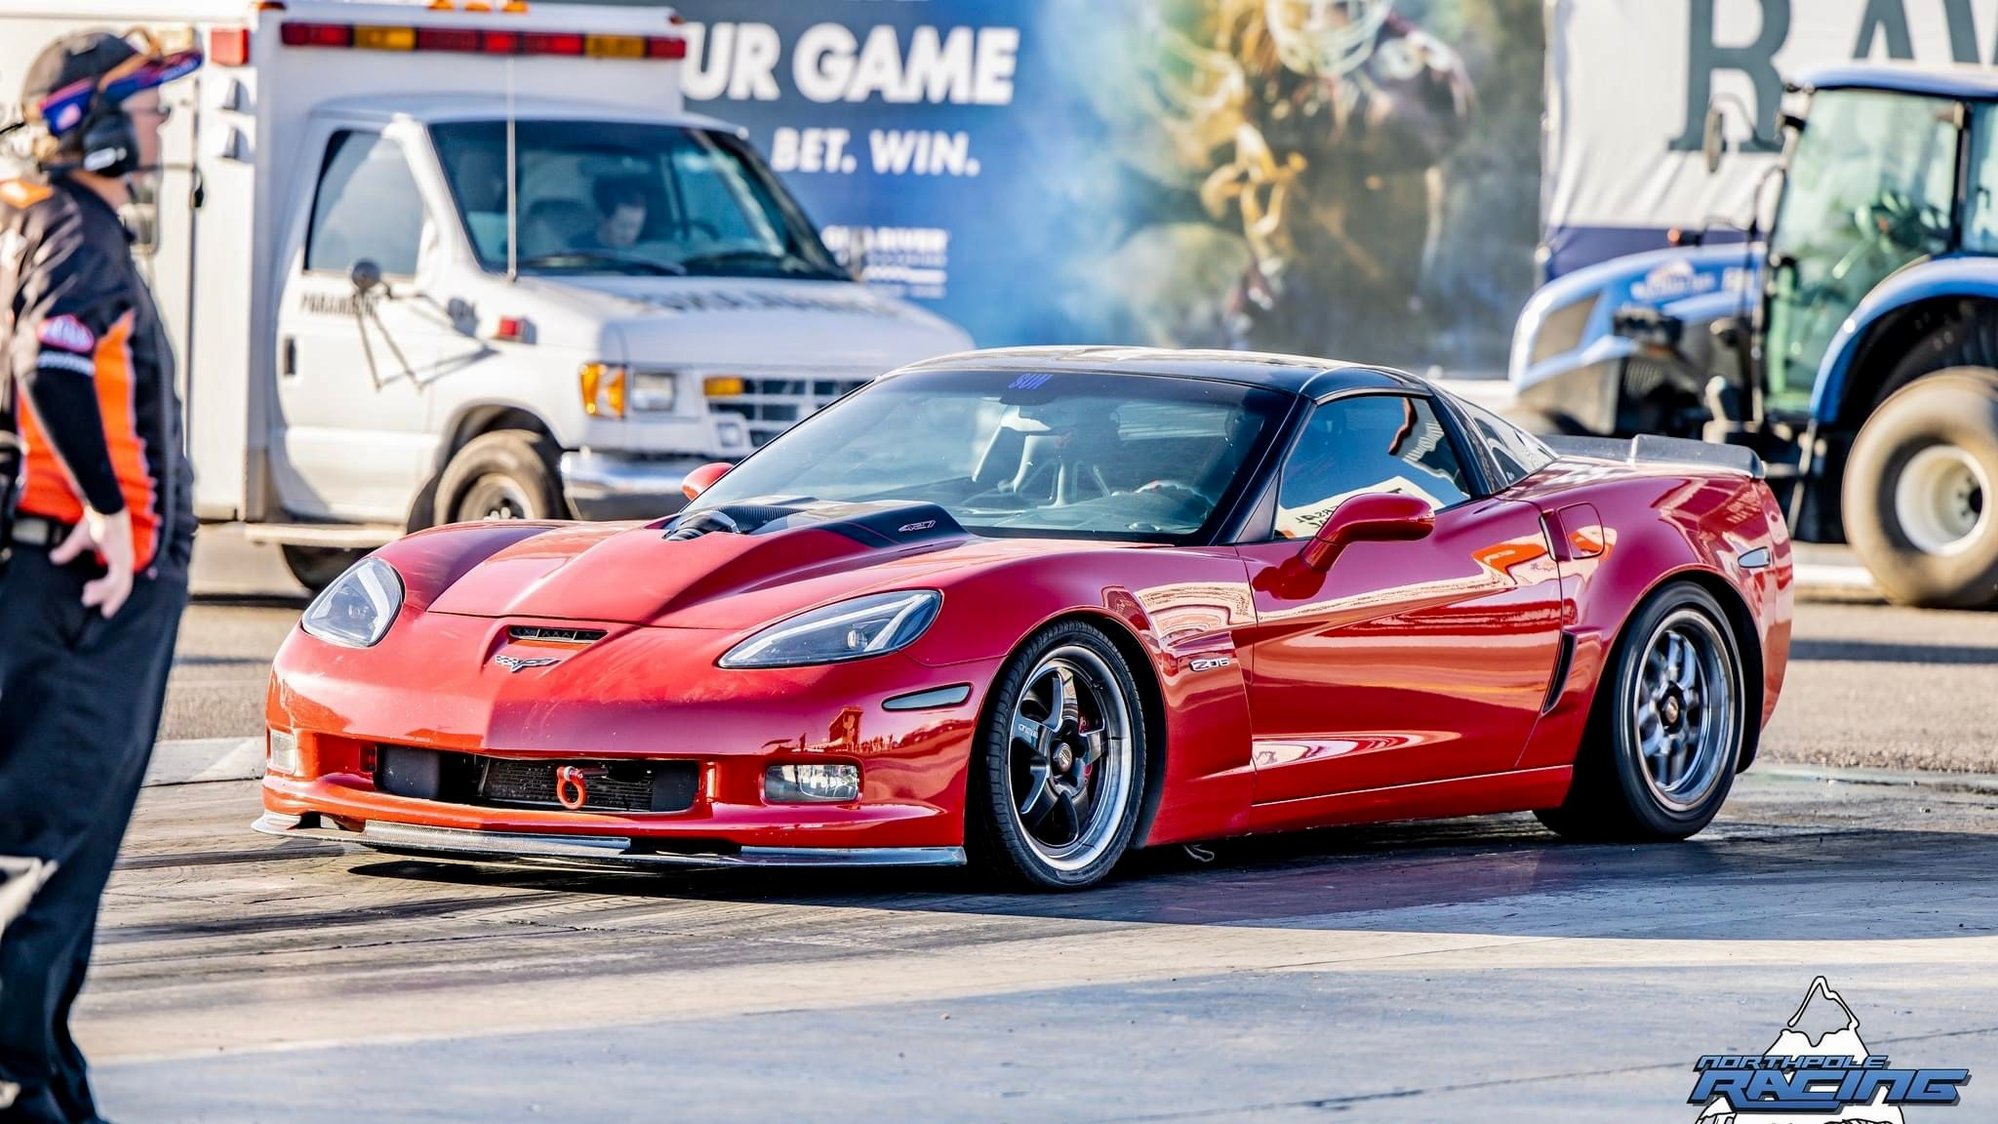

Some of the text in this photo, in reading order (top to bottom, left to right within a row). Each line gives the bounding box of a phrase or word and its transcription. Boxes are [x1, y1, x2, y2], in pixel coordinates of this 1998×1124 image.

[793, 22, 1020, 105] GAME
[770, 126, 981, 177] BET. WIN.
